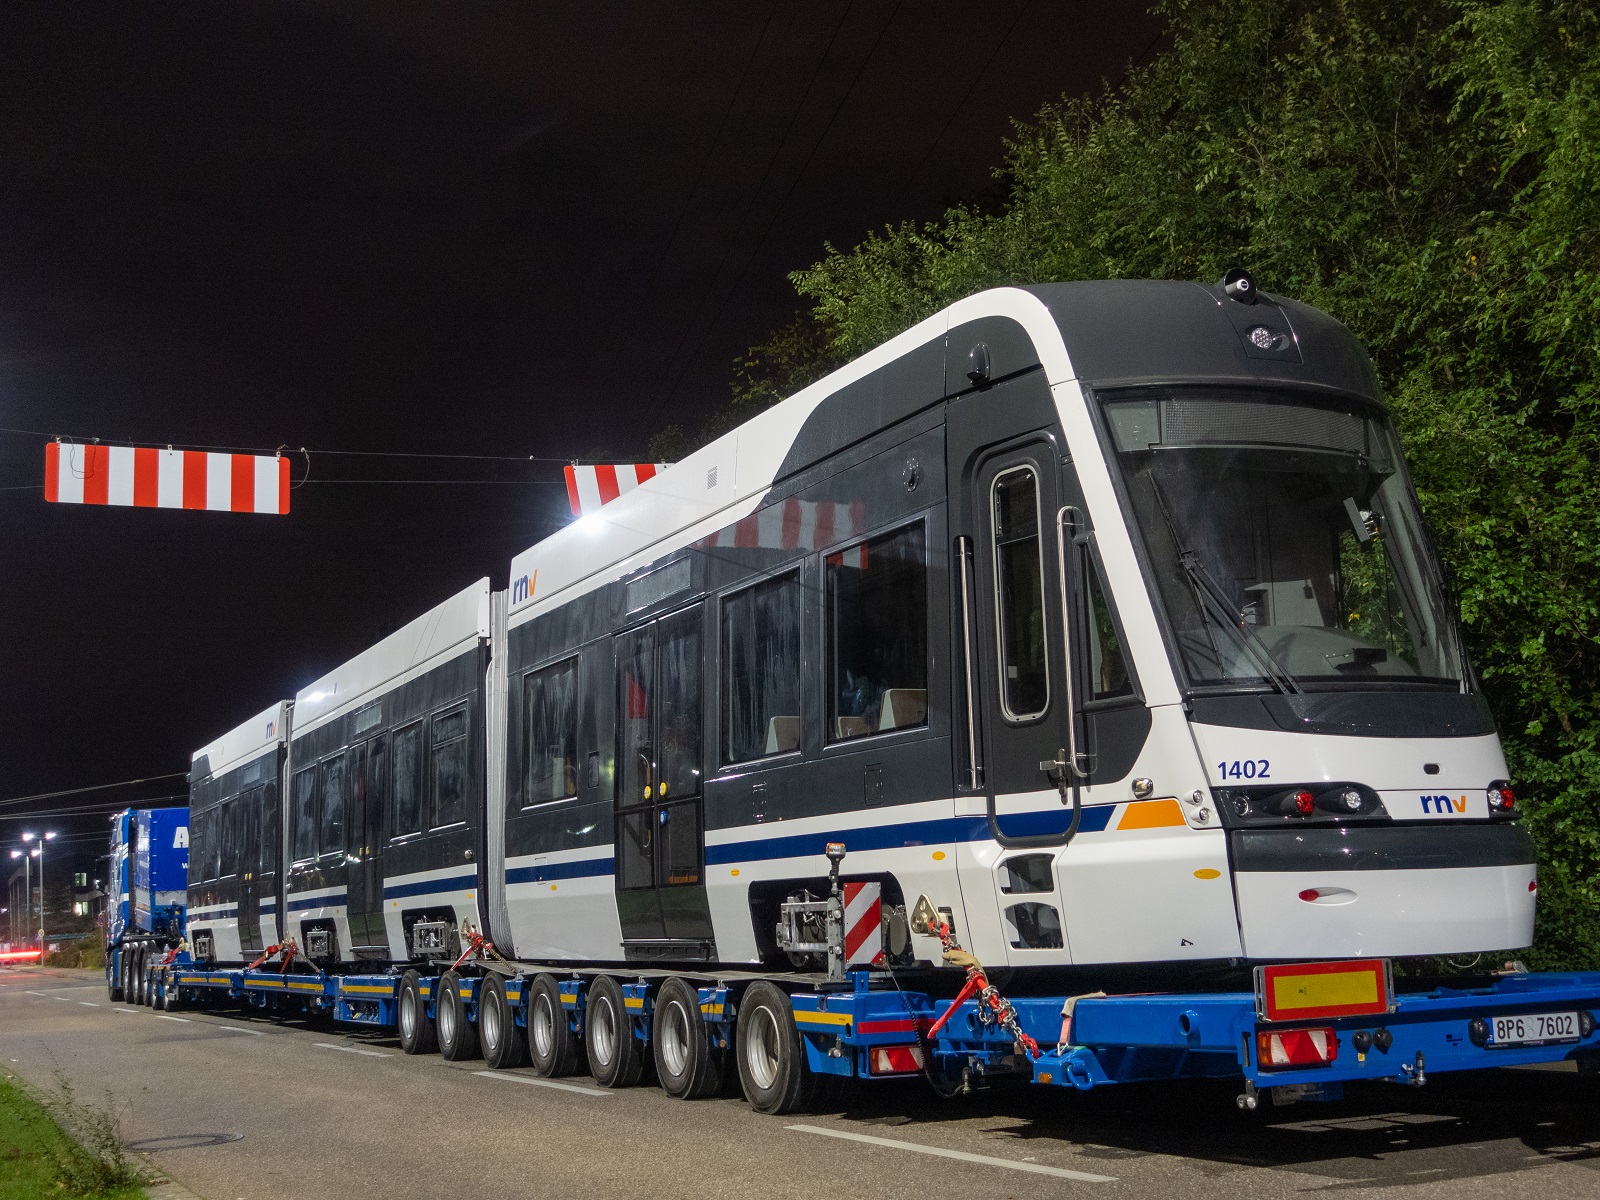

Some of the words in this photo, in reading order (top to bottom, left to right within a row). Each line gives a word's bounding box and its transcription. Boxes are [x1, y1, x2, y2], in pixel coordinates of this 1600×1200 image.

[513, 569, 538, 605] rnv
[1218, 759, 1270, 780] 1402
[1420, 795, 1466, 813] rnv
[1497, 1018, 1525, 1039] 8P6
[1537, 1015, 1574, 1037] 7602
